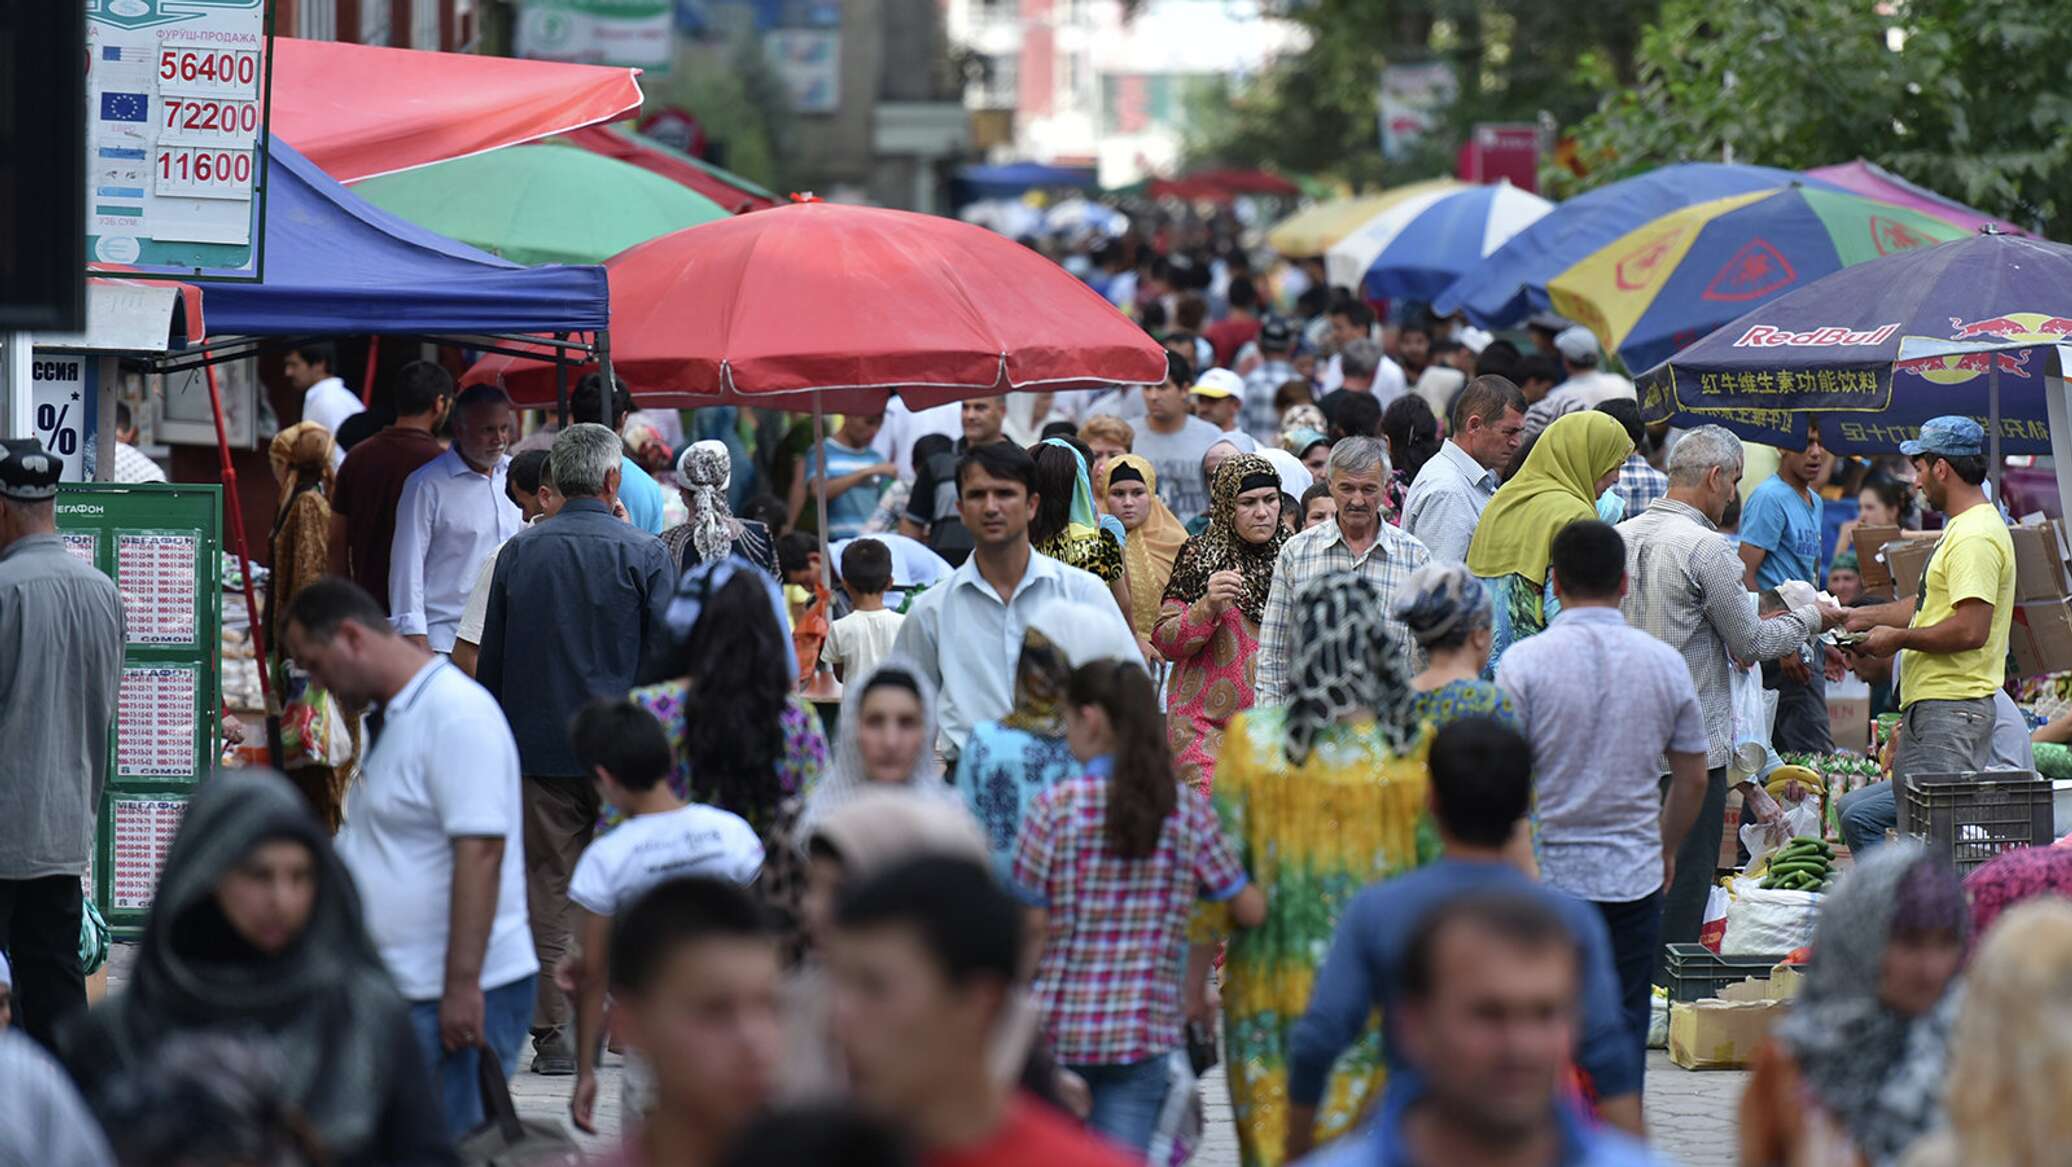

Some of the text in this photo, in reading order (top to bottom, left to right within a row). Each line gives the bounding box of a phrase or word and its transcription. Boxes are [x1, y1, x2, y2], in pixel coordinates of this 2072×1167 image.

[160, 51, 255, 84] 56400
[164, 101, 257, 132] 72200
[158, 152, 251, 182] 11600
[1700, 368, 1878, 396] 红牛维生素功能饮料
